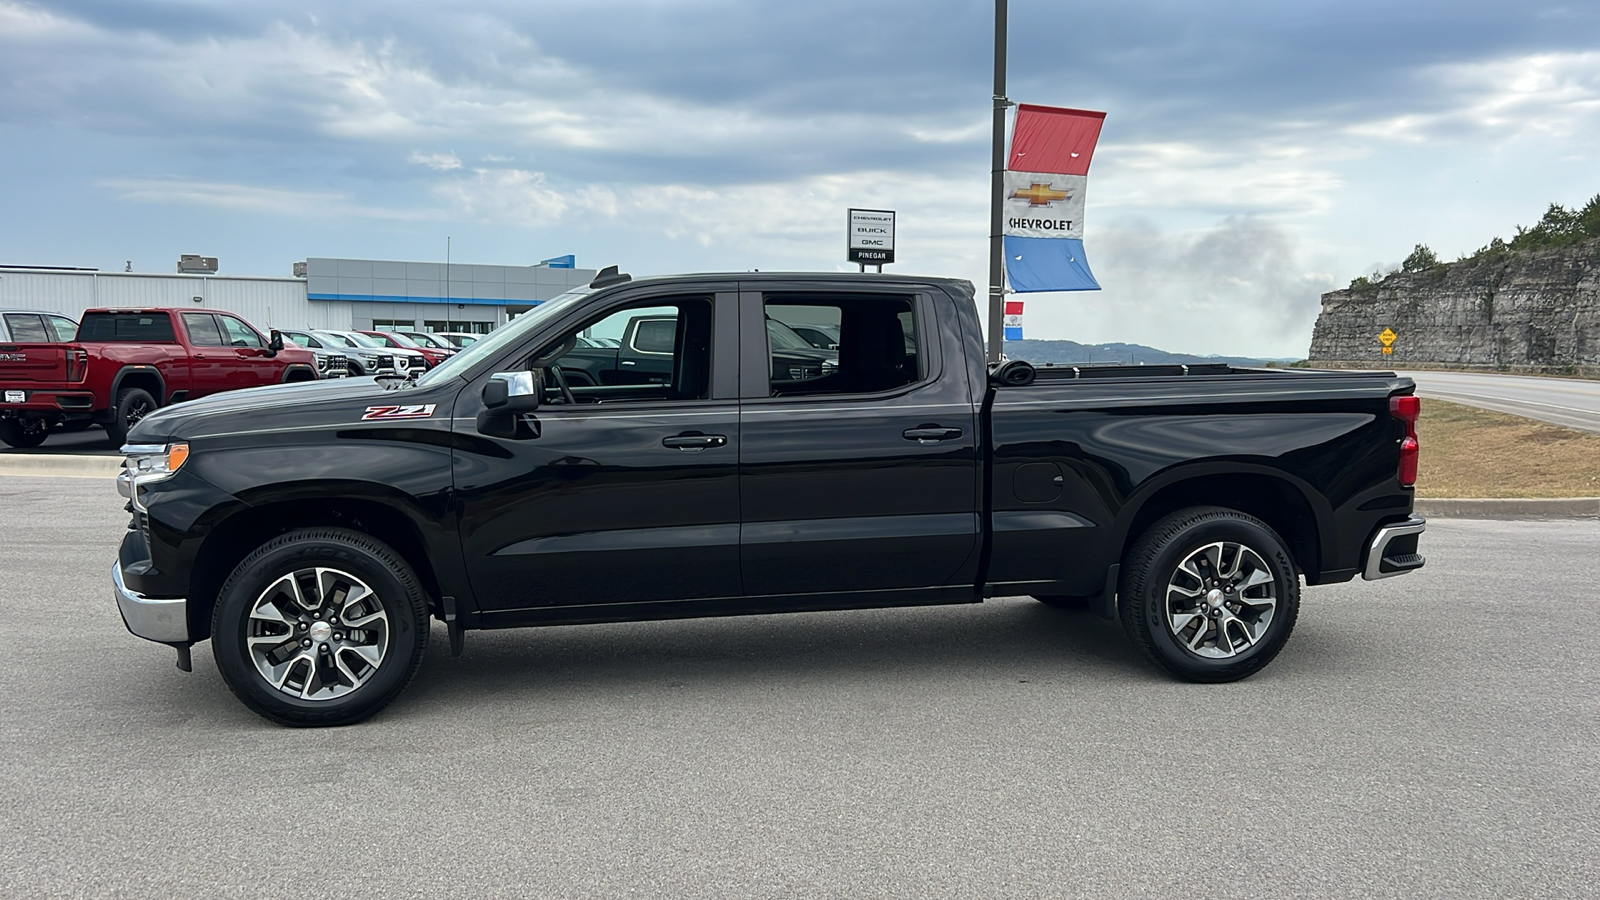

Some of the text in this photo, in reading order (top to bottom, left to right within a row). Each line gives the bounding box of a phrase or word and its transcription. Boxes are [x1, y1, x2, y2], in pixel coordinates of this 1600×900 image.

[1008, 217, 1073, 231] CHEVROLET
[858, 252, 887, 260] PINEGAR
[361, 404, 437, 420] Z71
